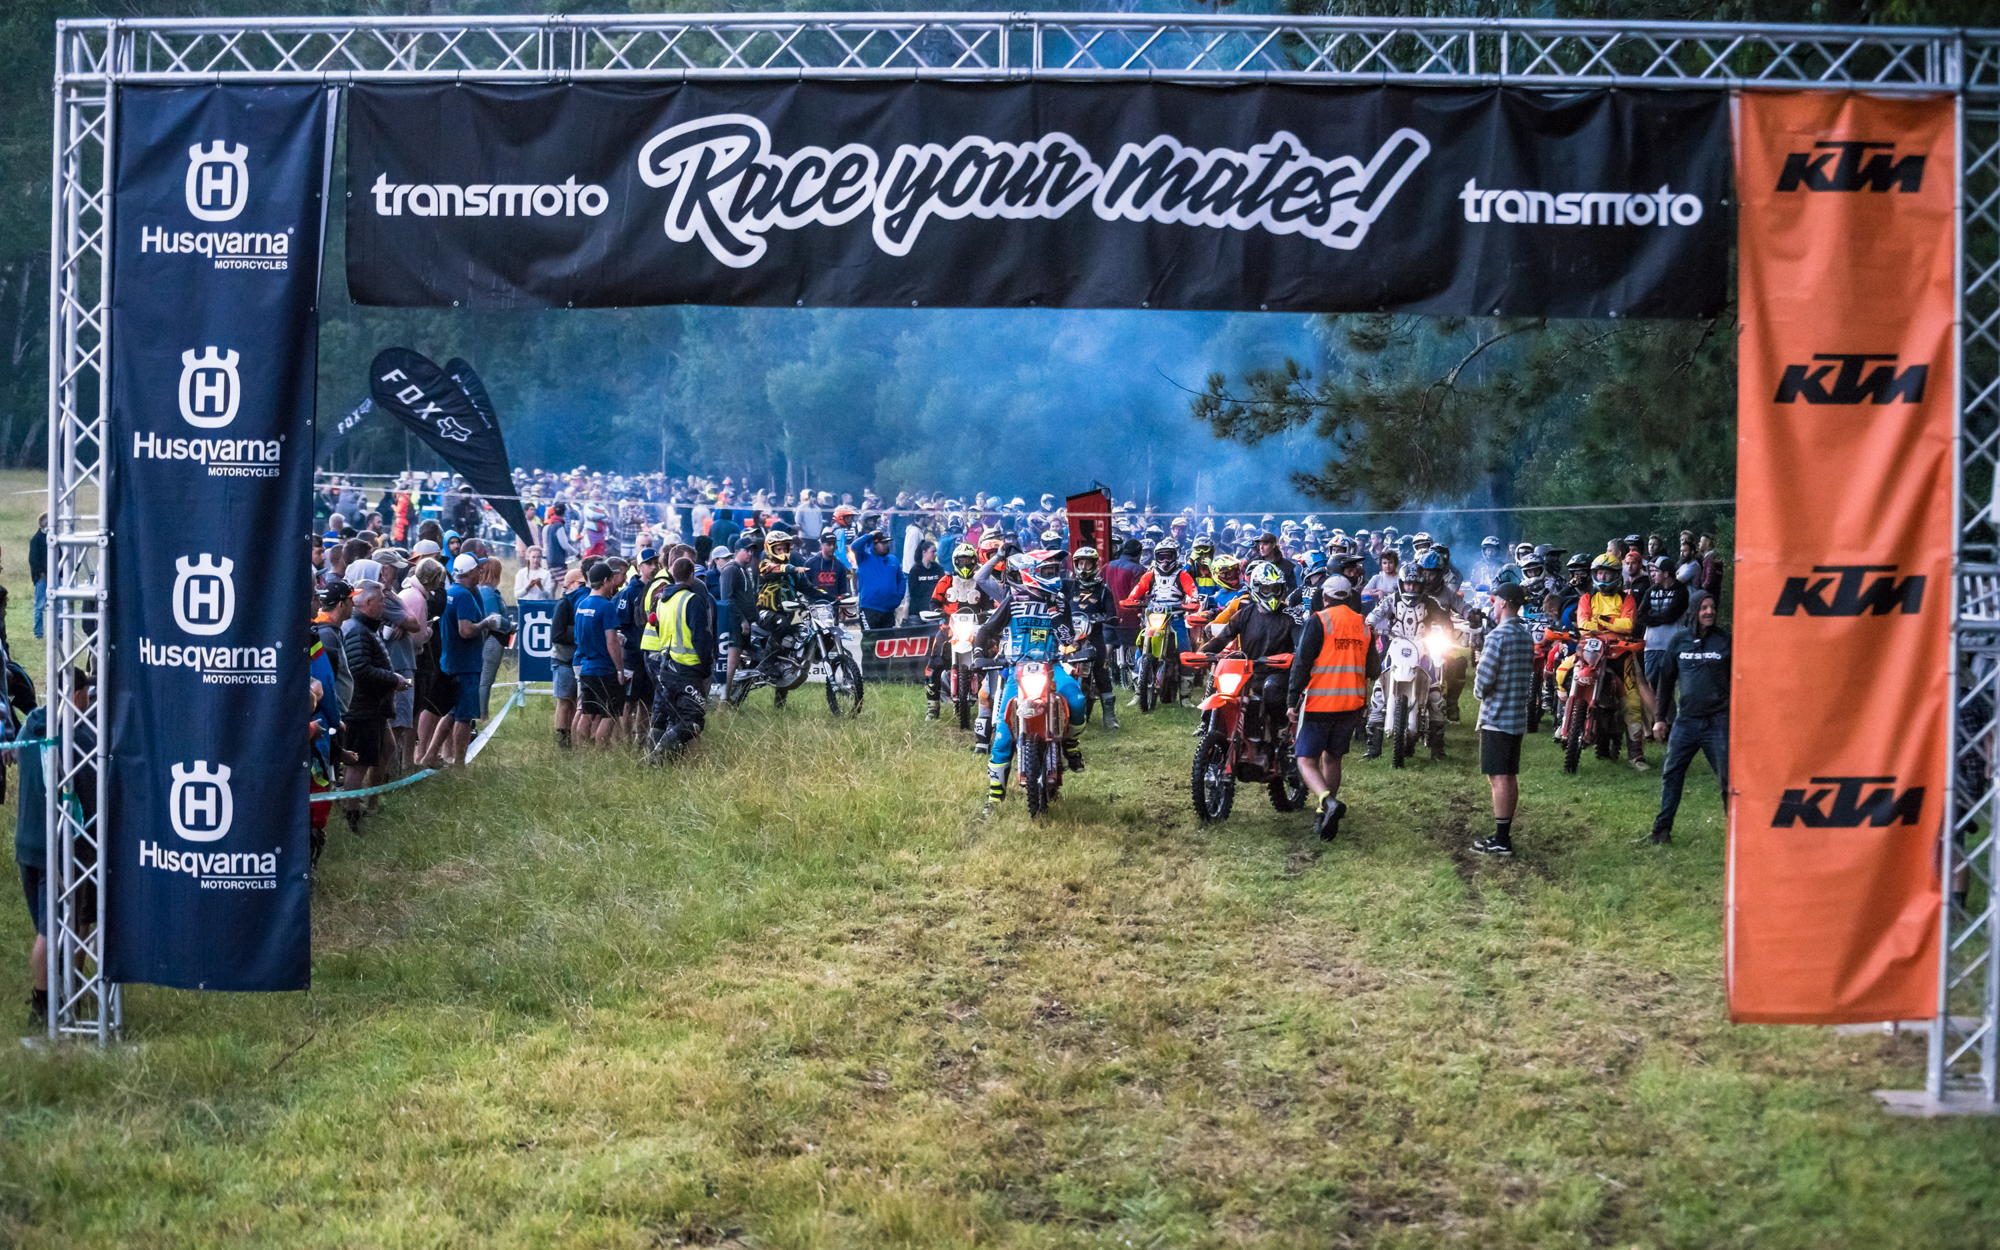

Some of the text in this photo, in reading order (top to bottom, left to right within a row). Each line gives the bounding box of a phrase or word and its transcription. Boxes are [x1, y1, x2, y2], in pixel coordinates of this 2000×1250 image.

[1776, 141, 1926, 193] KTM
[371, 173, 609, 216] transmoto
[638, 114, 1431, 268] Race your mates!
[1458, 178, 1702, 226] transmoto
[141, 226, 289, 258] Husqvarna
[214, 260, 288, 270] MOTORCYCLES
[381, 368, 443, 420] FOX
[1774, 354, 1928, 405] KTM
[337, 409, 362, 435] FOX
[133, 431, 281, 465] Husqvarna
[208, 467, 280, 477] MOTORCYCLES
[1774, 564, 1926, 617] KTM
[139, 637, 277, 672] Husqvarna
[875, 636, 930, 659] UNI
[202, 674, 277, 684] MOTORCYCLES
[1771, 777, 1926, 828] KTM
[139, 839, 276, 878] Husqvarna
[201, 879, 277, 889] MOTORCYCLES
